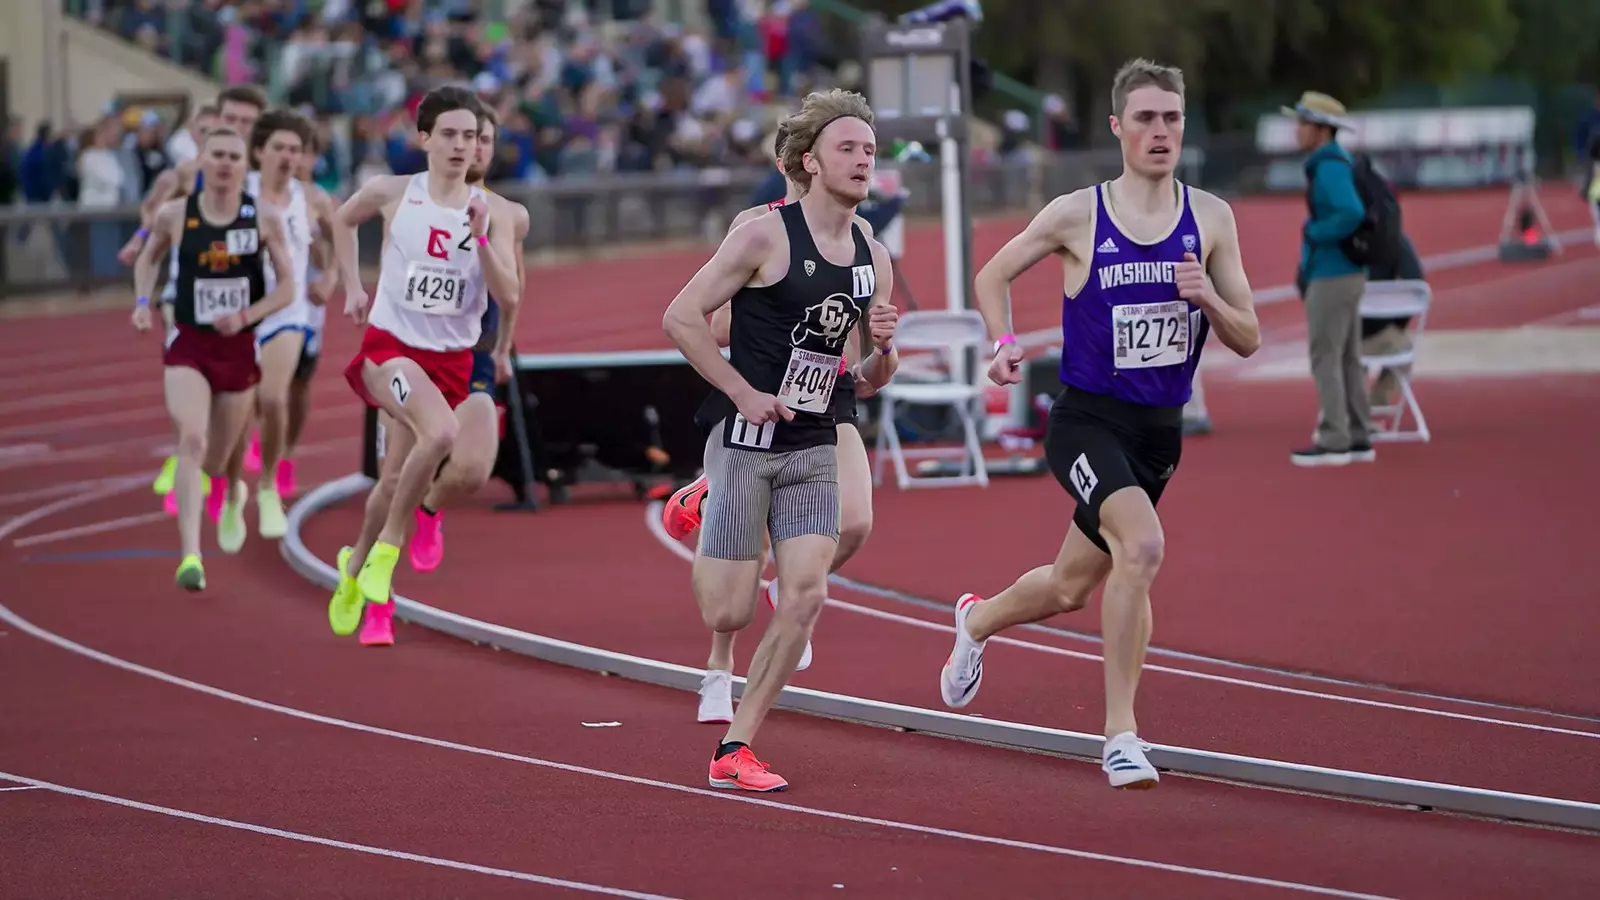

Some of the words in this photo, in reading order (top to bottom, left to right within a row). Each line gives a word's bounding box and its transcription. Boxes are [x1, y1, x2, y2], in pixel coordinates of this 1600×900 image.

[417, 275, 455, 301] 429
[854, 267, 871, 295] 11
[819, 300, 850, 338] CU
[1125, 317, 1179, 349] 1272
[798, 350, 826, 365] STANFORD
[392, 376, 407, 402] 2
[794, 365, 830, 396] 404
[1075, 461, 1092, 493] 4
